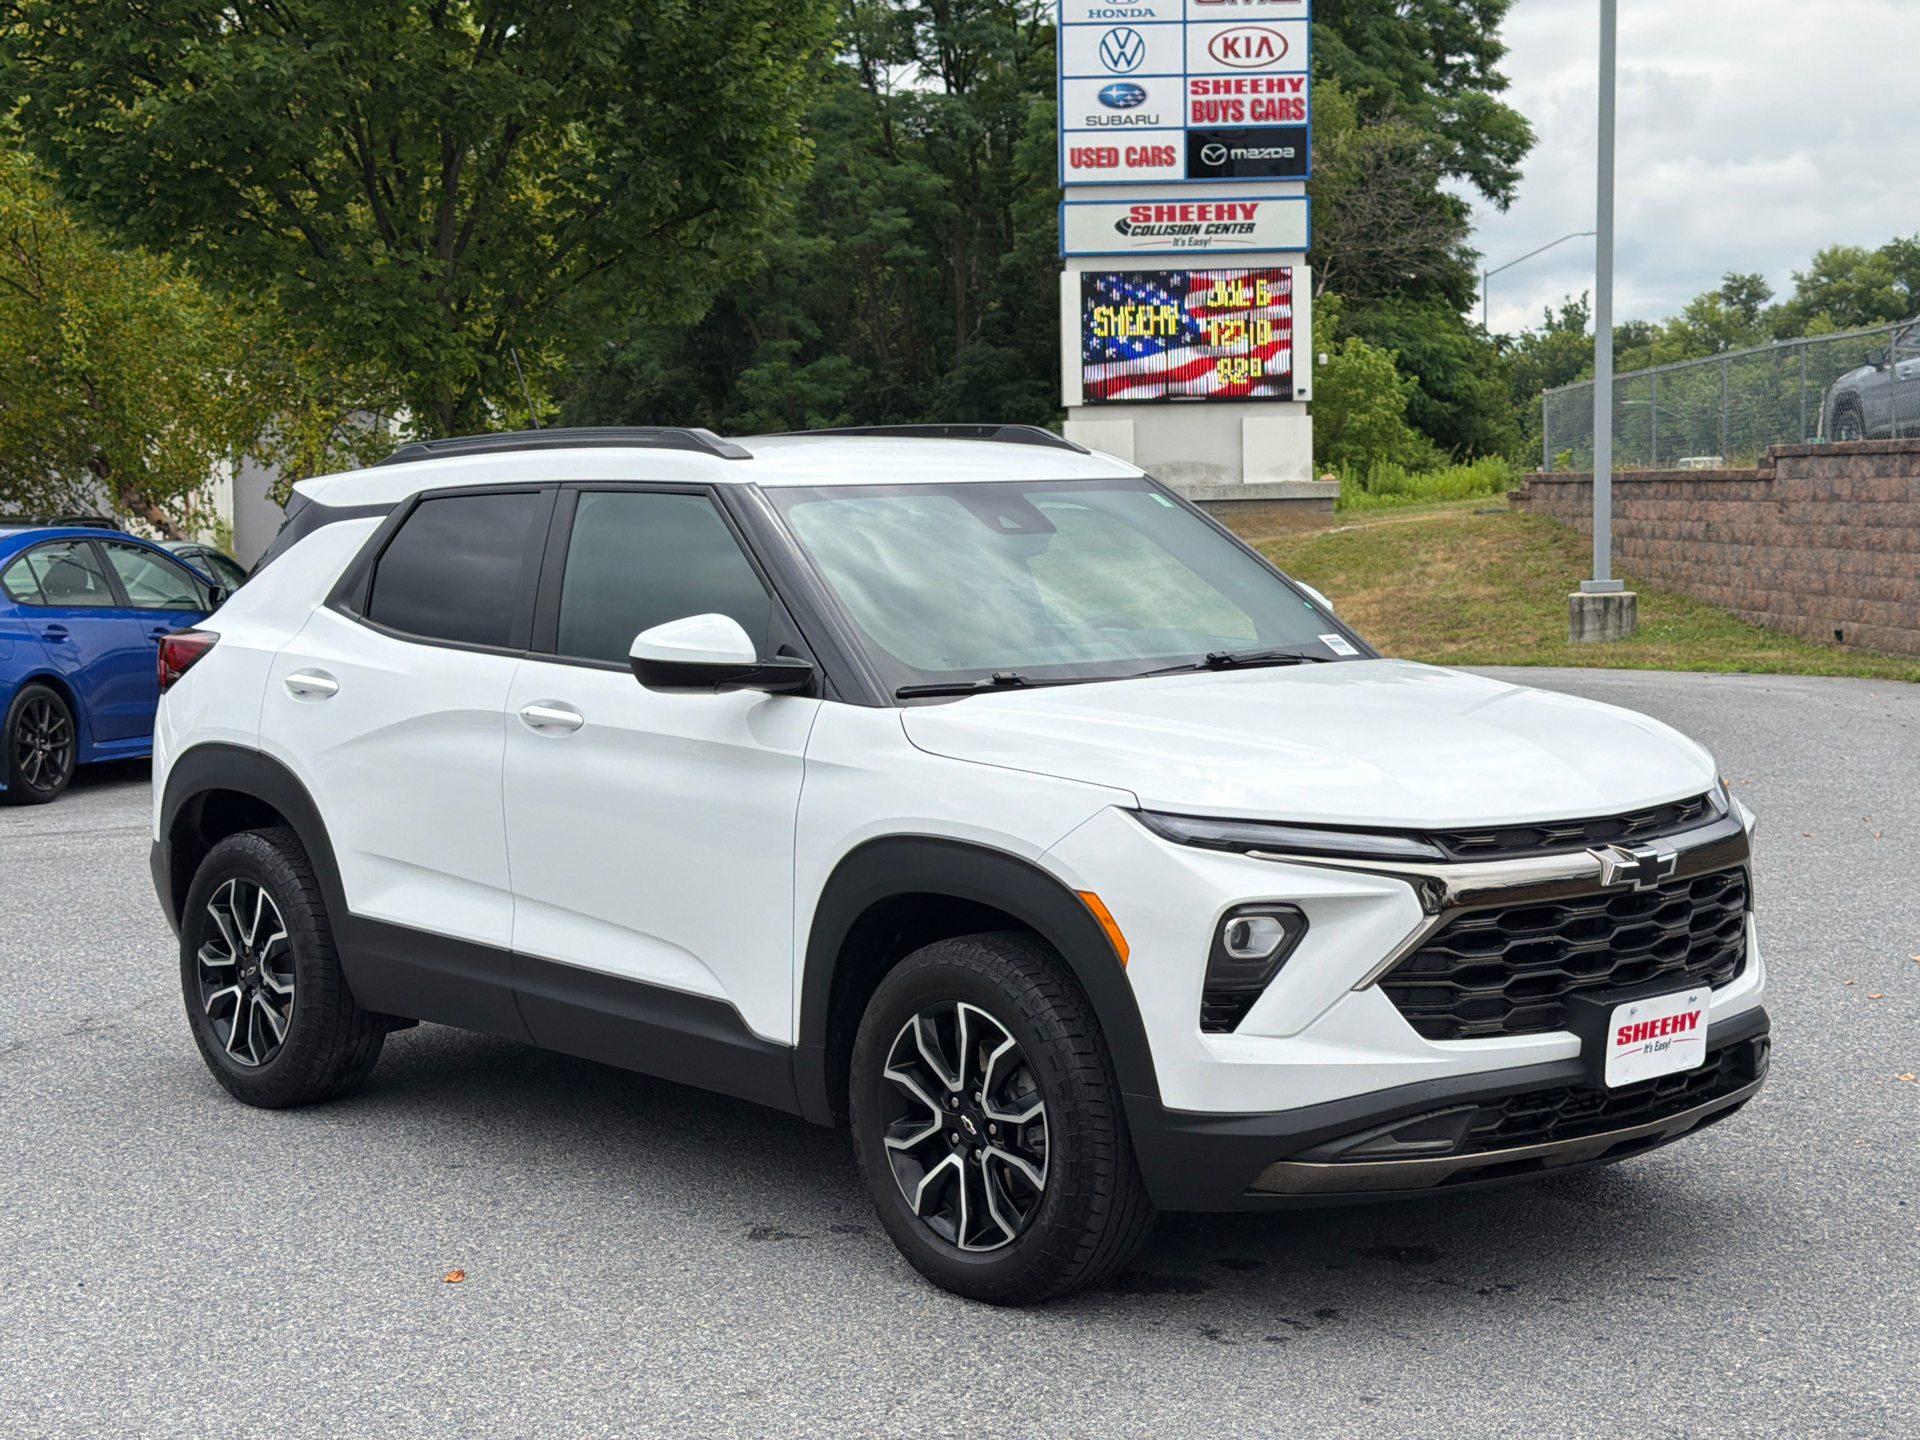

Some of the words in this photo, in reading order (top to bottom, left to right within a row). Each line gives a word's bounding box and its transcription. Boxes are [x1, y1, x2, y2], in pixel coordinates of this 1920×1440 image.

[1088, 9, 1156, 19] HONDA
[1223, 36, 1275, 58] KIA
[1190, 77, 1305, 96] SHEEHY
[1085, 114, 1160, 126] SUBARU
[1191, 99, 1245, 123] BUYS
[1250, 97, 1305, 122] CARS
[1070, 146, 1120, 169] USED
[1125, 145, 1176, 168] CARS
[1129, 203, 1259, 224] SHEEHY
[1131, 224, 1206, 237] COLLISION
[1204, 222, 1257, 235] CENTER
[1173, 237, 1187, 247] It's
[1187, 236, 1212, 248] Easy!
[1093, 305, 1178, 336] SHEEHY
[1617, 1010, 1702, 1046] SHEEHY
[1643, 1042, 1653, 1054] It's
[1654, 1038, 1672, 1053] Easy!
